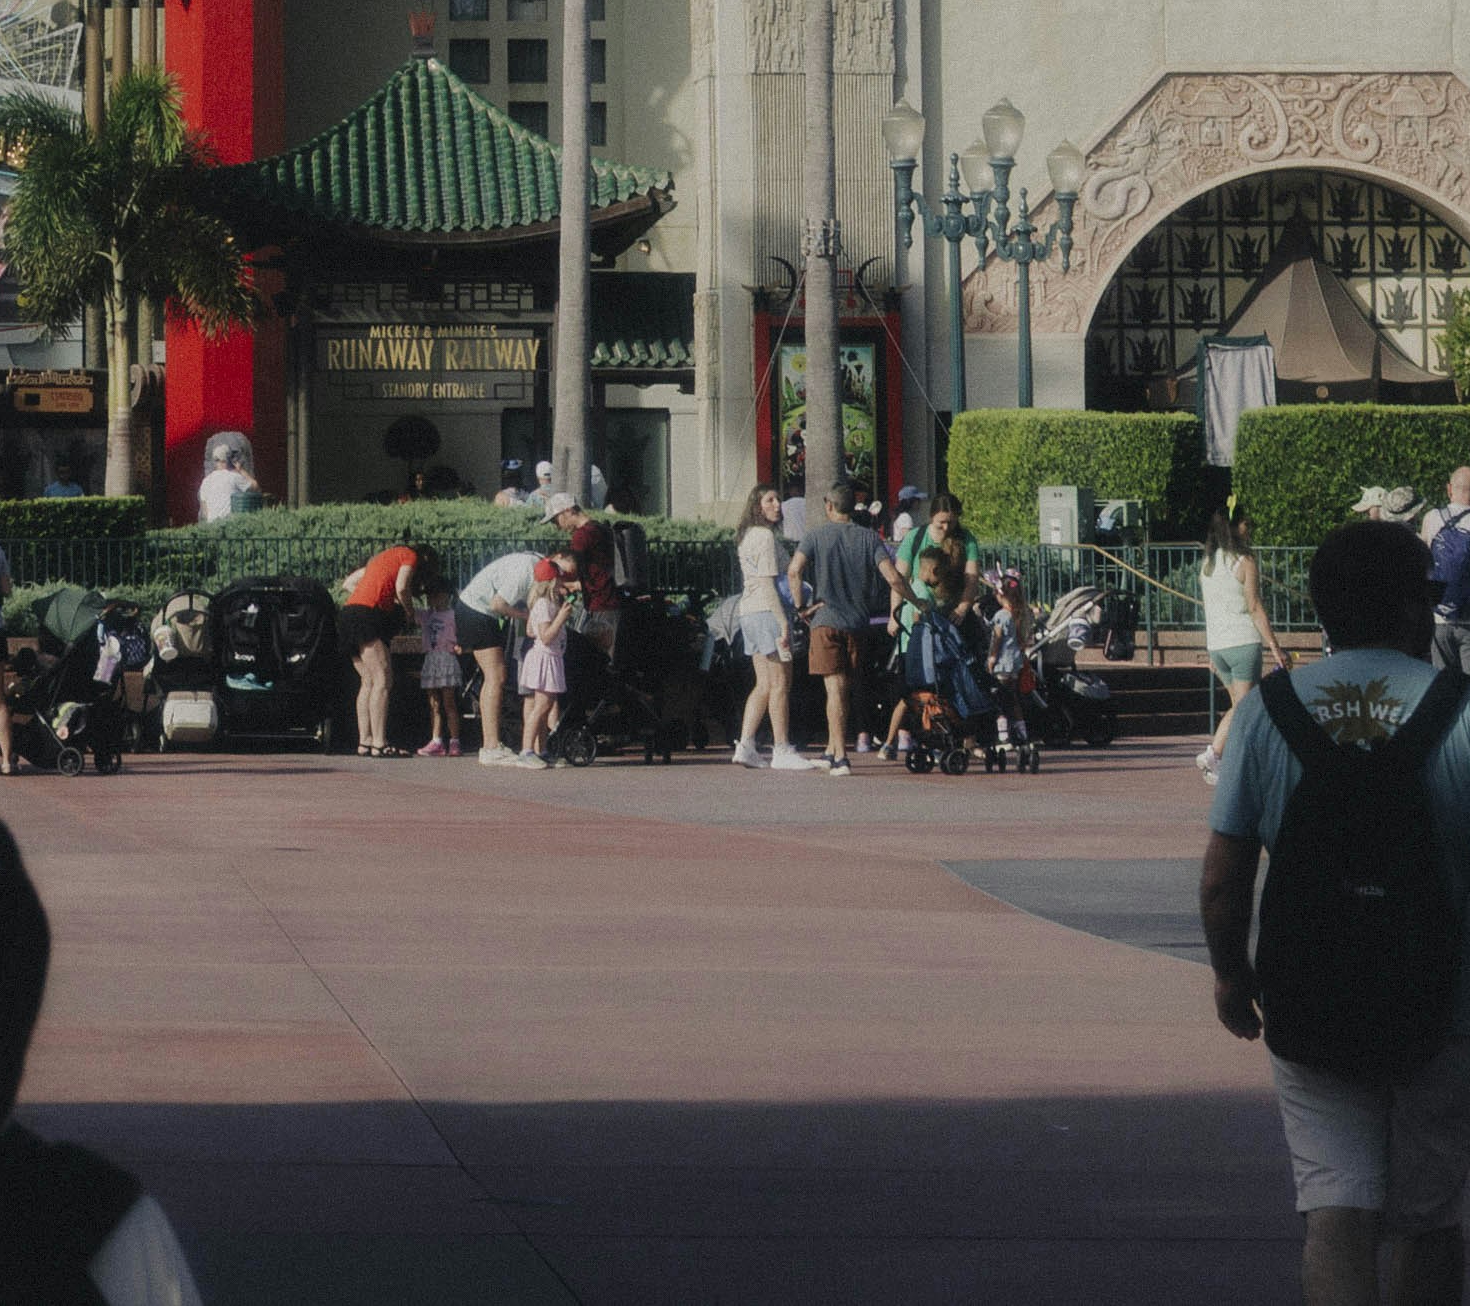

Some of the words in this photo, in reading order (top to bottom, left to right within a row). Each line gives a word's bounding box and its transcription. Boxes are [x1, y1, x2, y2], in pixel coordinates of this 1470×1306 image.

[369, 325, 420, 339] MICKEY
[422, 325, 432, 339] &
[437, 325, 498, 339] MINNIE'S
[327, 338, 435, 370] RUNAWAY
[444, 338, 540, 370] RAILWAY
[381, 382, 428, 399] STANDBY
[431, 382, 485, 399] ENTRANCE
[1315, 700, 1362, 723] RSH
